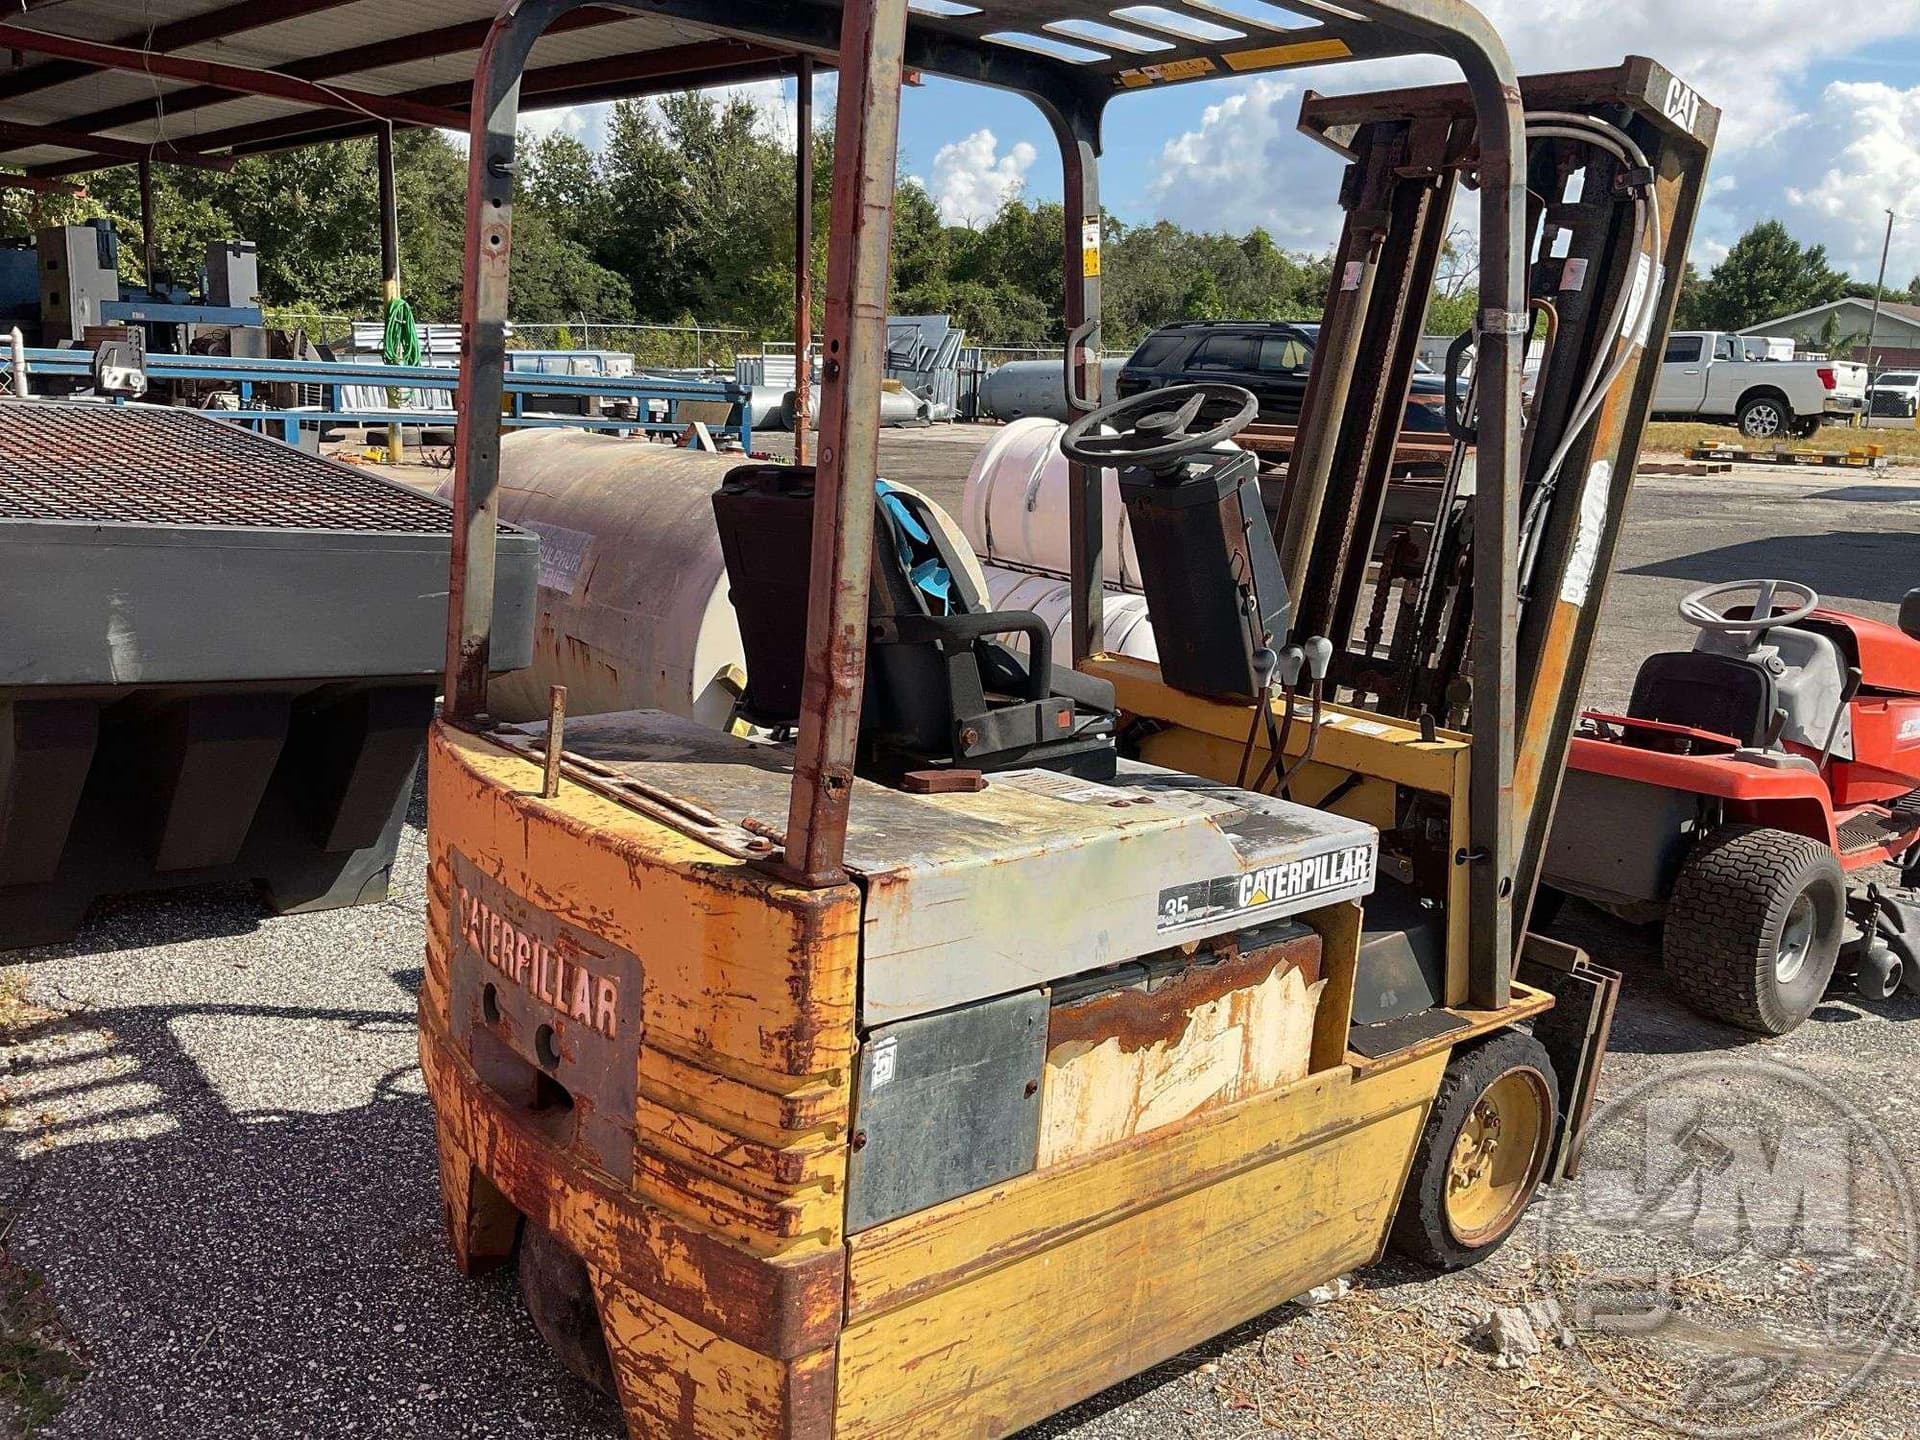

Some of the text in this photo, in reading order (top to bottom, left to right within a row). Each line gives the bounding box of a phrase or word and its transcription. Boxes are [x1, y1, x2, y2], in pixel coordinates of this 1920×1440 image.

[1663, 76, 1702, 134] CAT
[540, 545, 581, 572] ULPHUR
[1238, 846, 1371, 907] CATERPILLAR
[1164, 895, 1189, 927] 35
[458, 887, 619, 1040] CATERPILLAR
